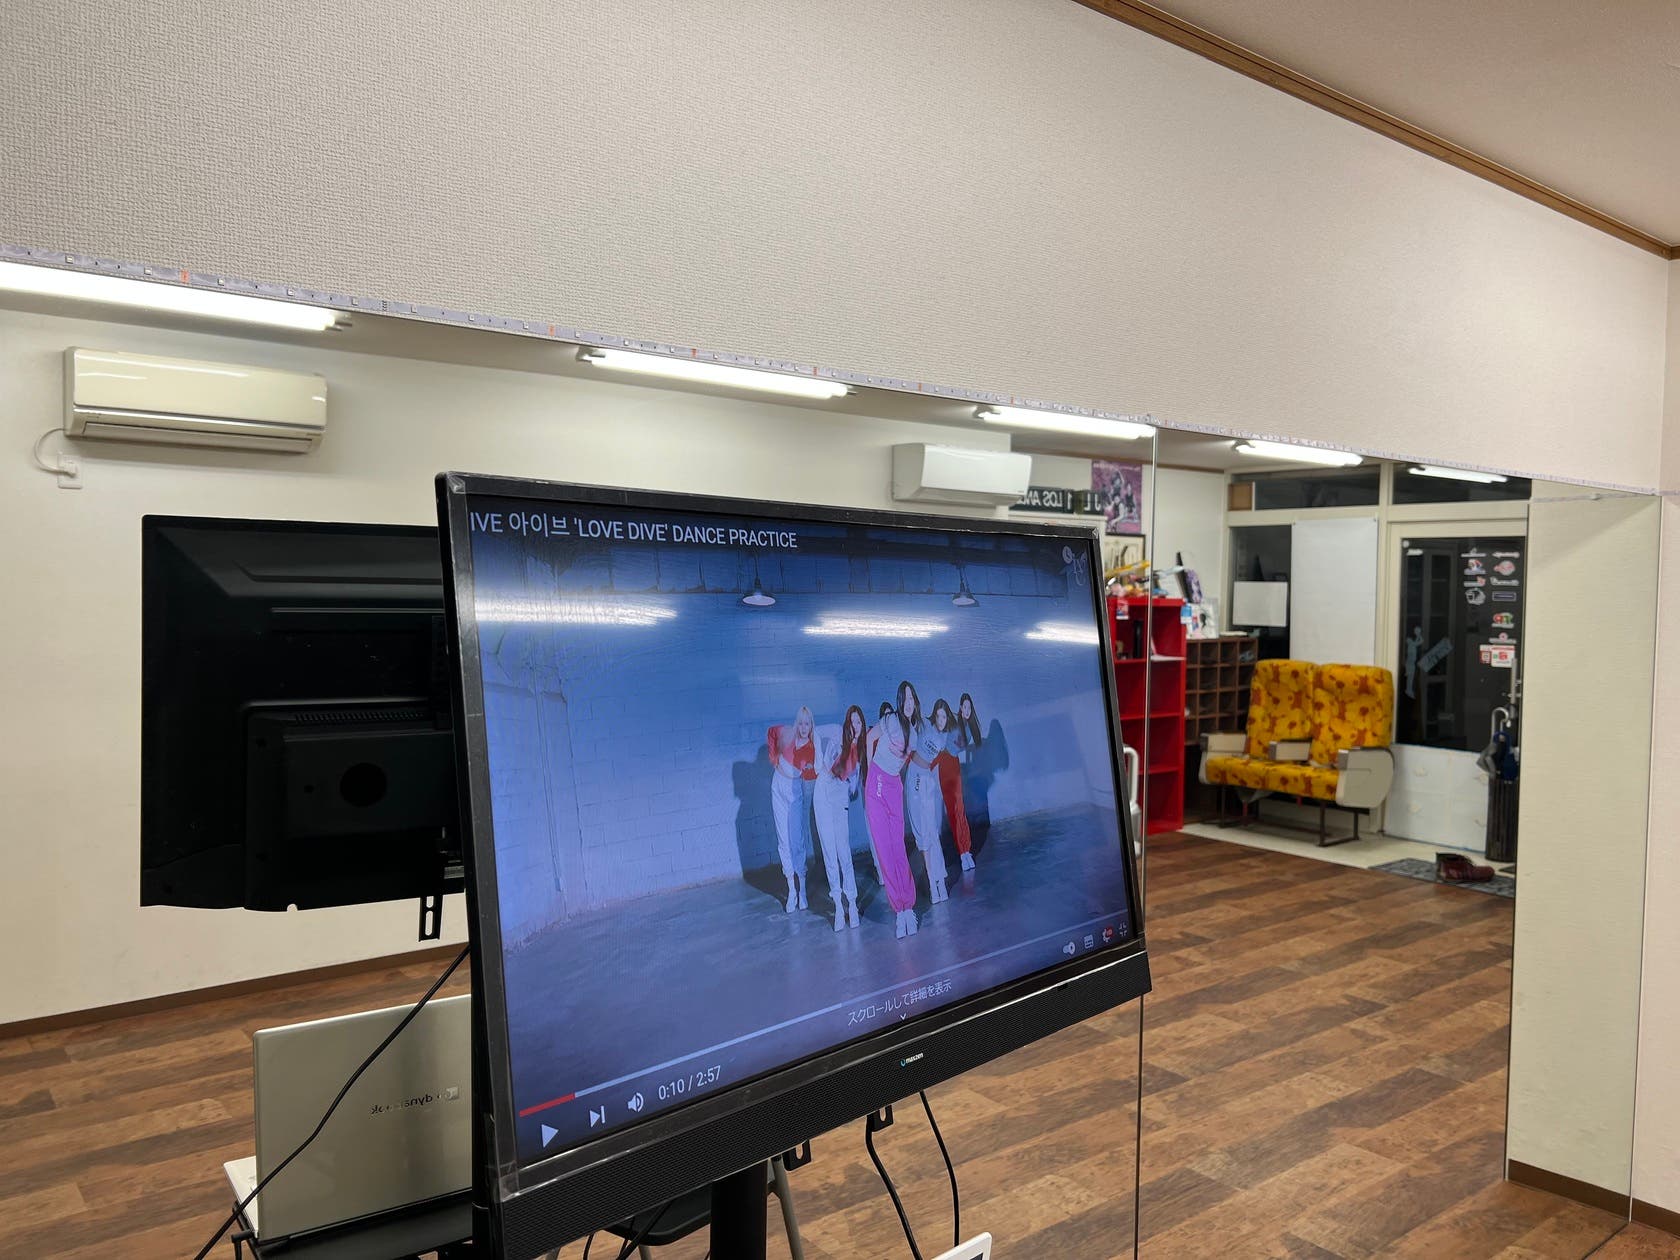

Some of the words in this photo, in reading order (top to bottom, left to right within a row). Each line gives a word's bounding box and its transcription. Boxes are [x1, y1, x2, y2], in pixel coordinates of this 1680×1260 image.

[470, 511, 503, 533] IVE
[508, 511, 570, 537] 아이브
[574, 517, 624, 539] 'LOVE
[628, 521, 668, 541] DIVE'
[672, 524, 726, 545] DANCE
[729, 528, 798, 548] PRACTICE
[847, 978, 952, 1026] スクロールして詳細を表示
[658, 1079, 685, 1100] 0:10
[696, 1065, 721, 1087] 2:57
